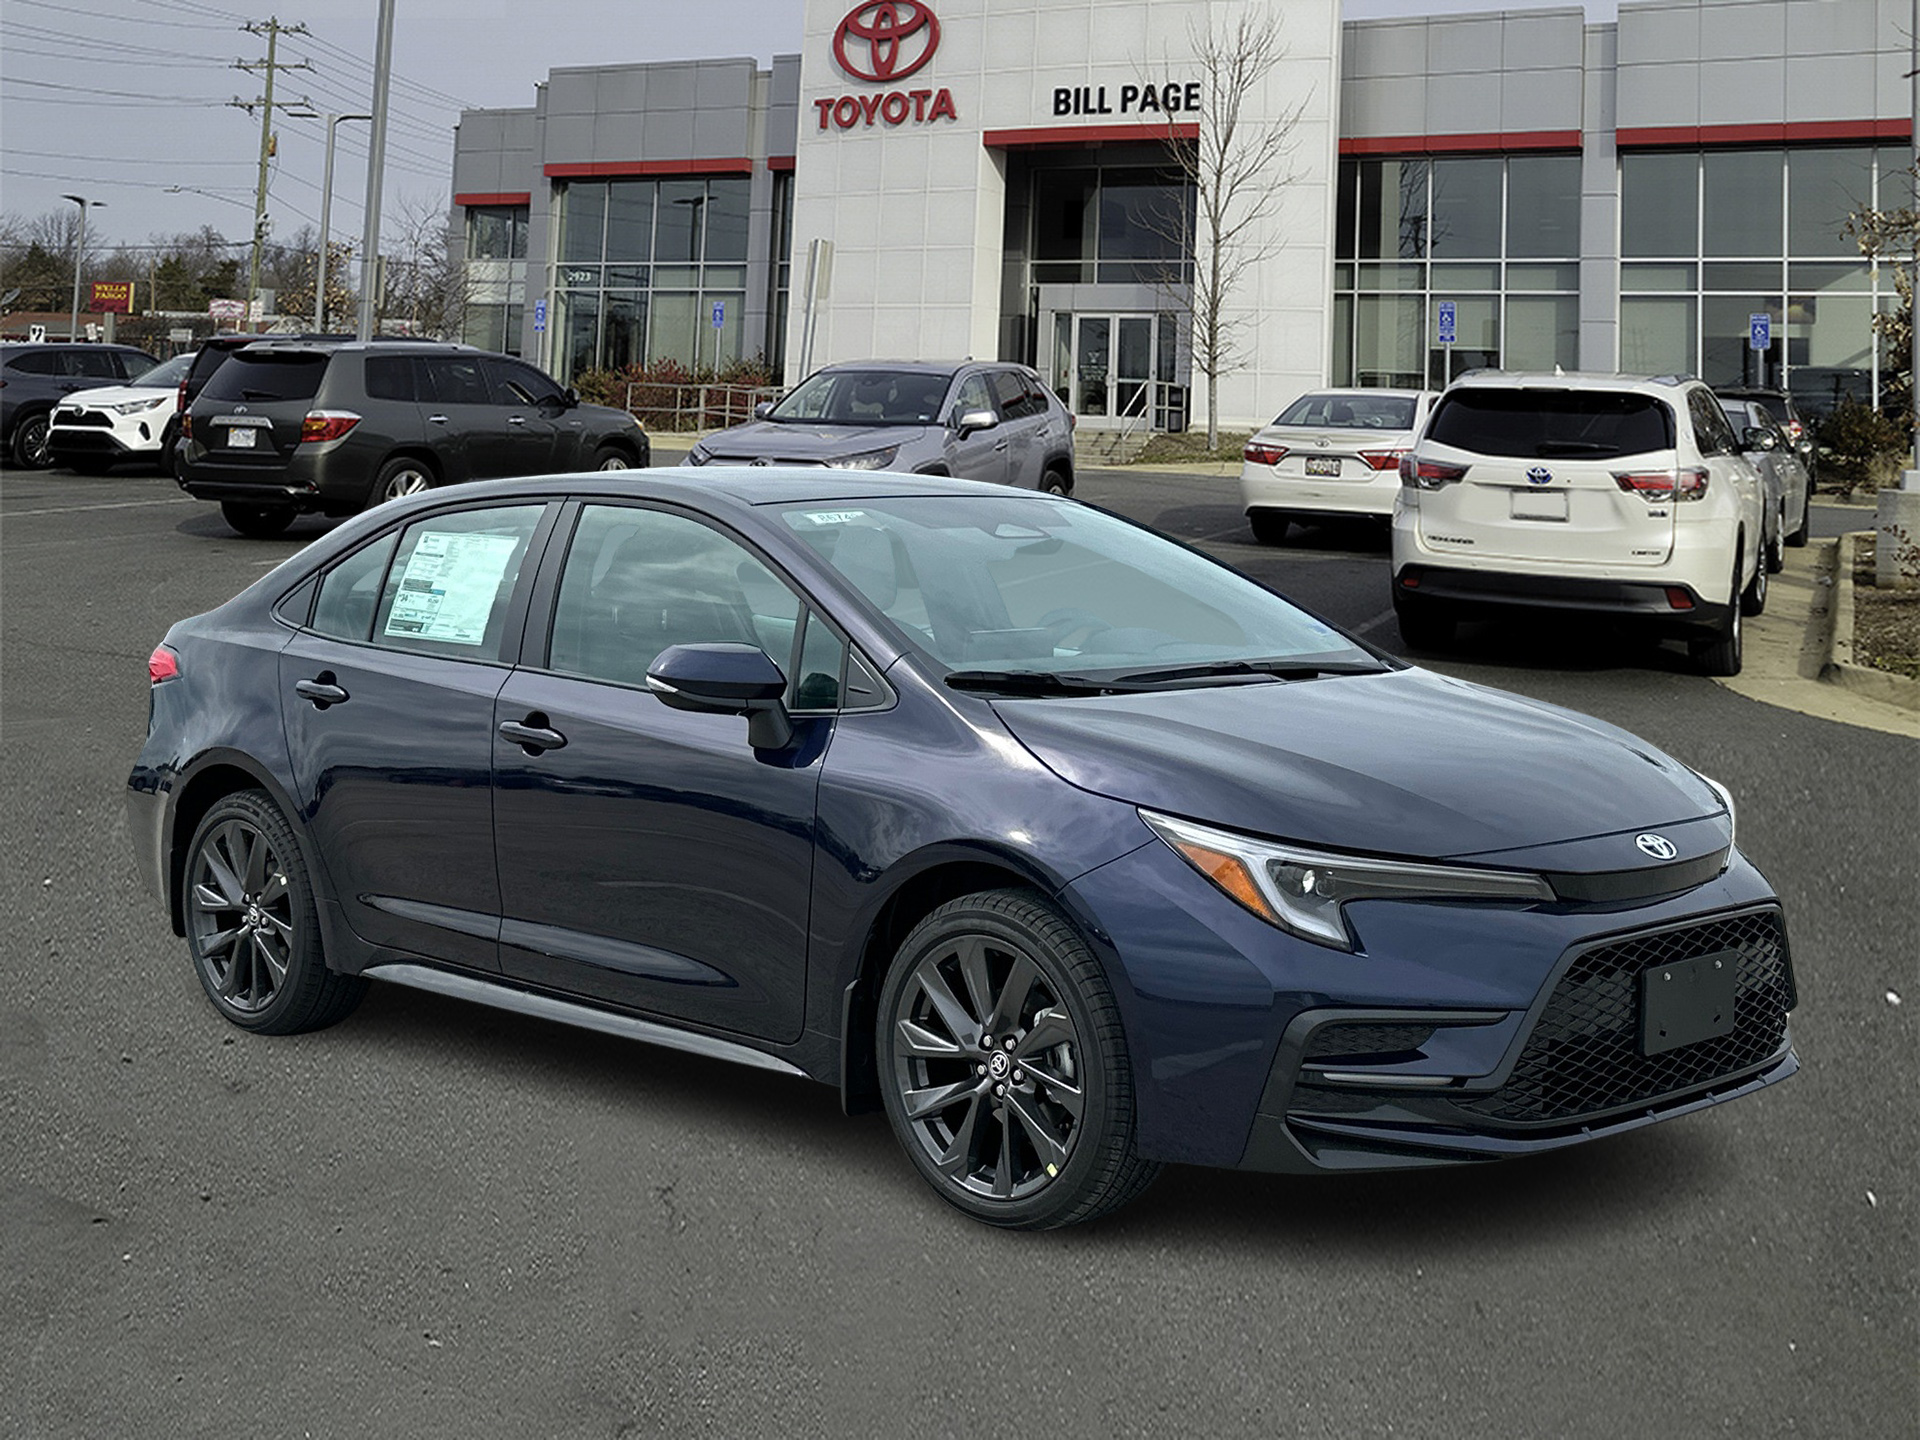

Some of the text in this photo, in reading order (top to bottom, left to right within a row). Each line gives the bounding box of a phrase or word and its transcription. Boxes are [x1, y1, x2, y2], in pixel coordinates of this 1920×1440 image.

[814, 88, 957, 129] TOYOTA
[1053, 83, 1200, 115] BILL PAGE
[567, 271, 591, 281] 2923
[95, 292, 127, 300] FARGO
